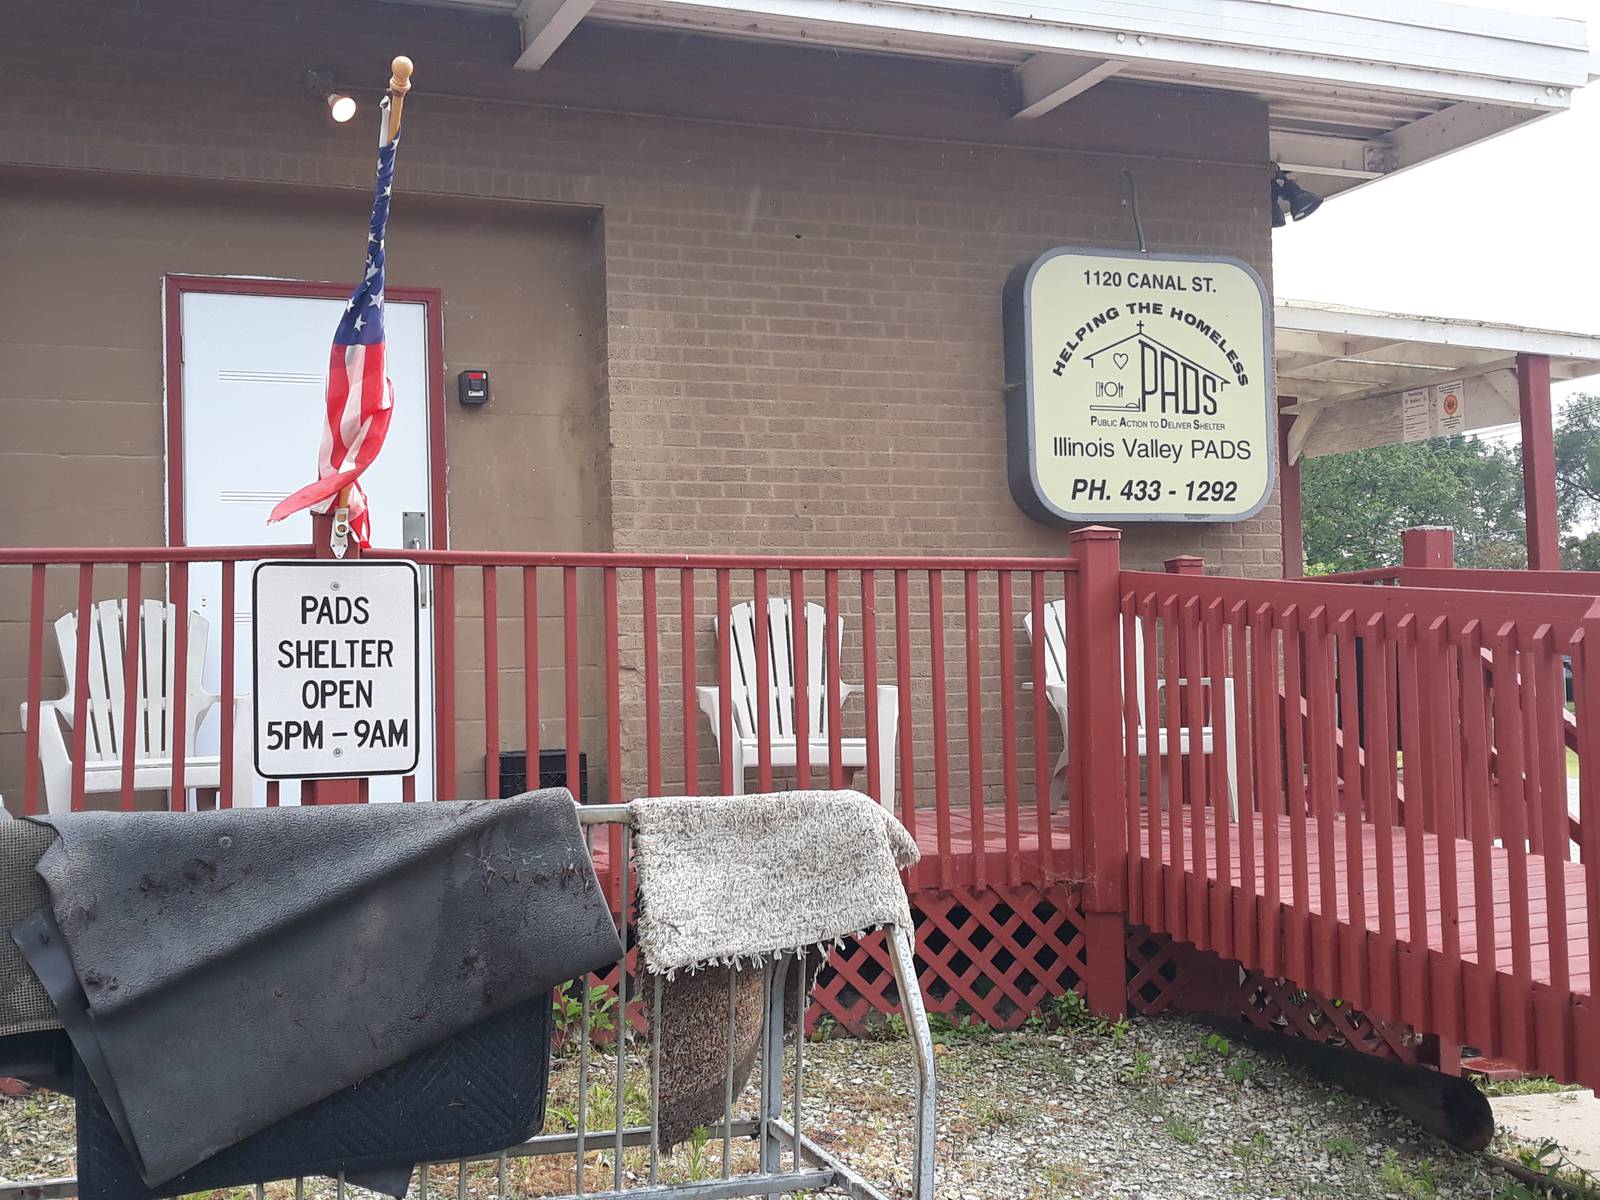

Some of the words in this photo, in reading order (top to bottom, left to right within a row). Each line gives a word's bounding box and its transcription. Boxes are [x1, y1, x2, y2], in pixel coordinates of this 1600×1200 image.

[1084, 271, 1122, 287] 1120
[1128, 273, 1186, 290] CANAL
[1192, 277, 1216, 293] ST.
[1053, 307, 1119, 377] HELPING
[1126, 303, 1163, 314] THE
[1170, 307, 1248, 386] HOMELESS
[1138, 339, 1217, 415] PADS
[1054, 437, 1114, 457] Illinois
[1123, 438, 1182, 463] Valley
[1191, 440, 1251, 459] PADS
[1071, 479, 1111, 500] PH.
[1120, 480, 1161, 501] 433
[1185, 481, 1237, 501] 1292
[302, 596, 369, 624] PADS
[278, 640, 393, 668] SHELTER
[302, 680, 372, 709] OPEN
[267, 720, 323, 750] 5PM
[354, 719, 407, 748] 9AM
